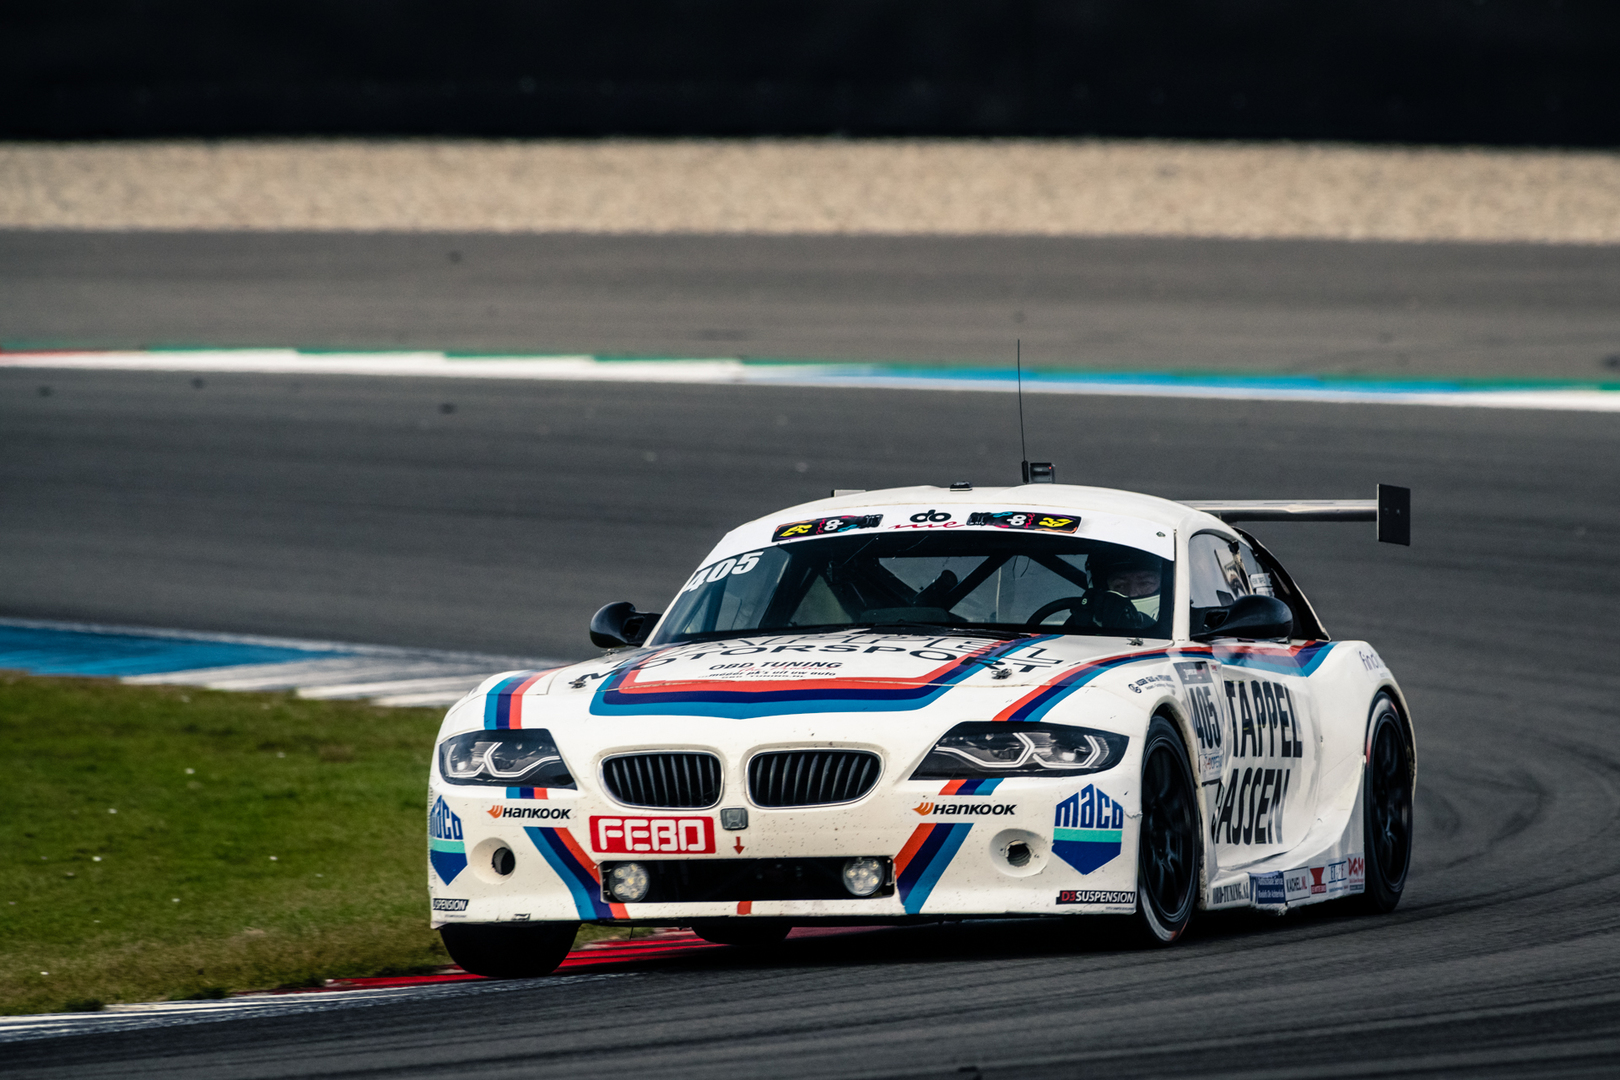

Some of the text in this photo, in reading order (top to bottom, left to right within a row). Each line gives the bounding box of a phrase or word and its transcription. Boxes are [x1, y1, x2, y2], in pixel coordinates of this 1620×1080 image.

[683, 551, 764, 593] 405
[760, 661, 843, 669] TUNING
[1188, 684, 1221, 749] 405
[1224, 680, 1303, 758] TAPPEL
[1216, 767, 1291, 845] ASSEN
